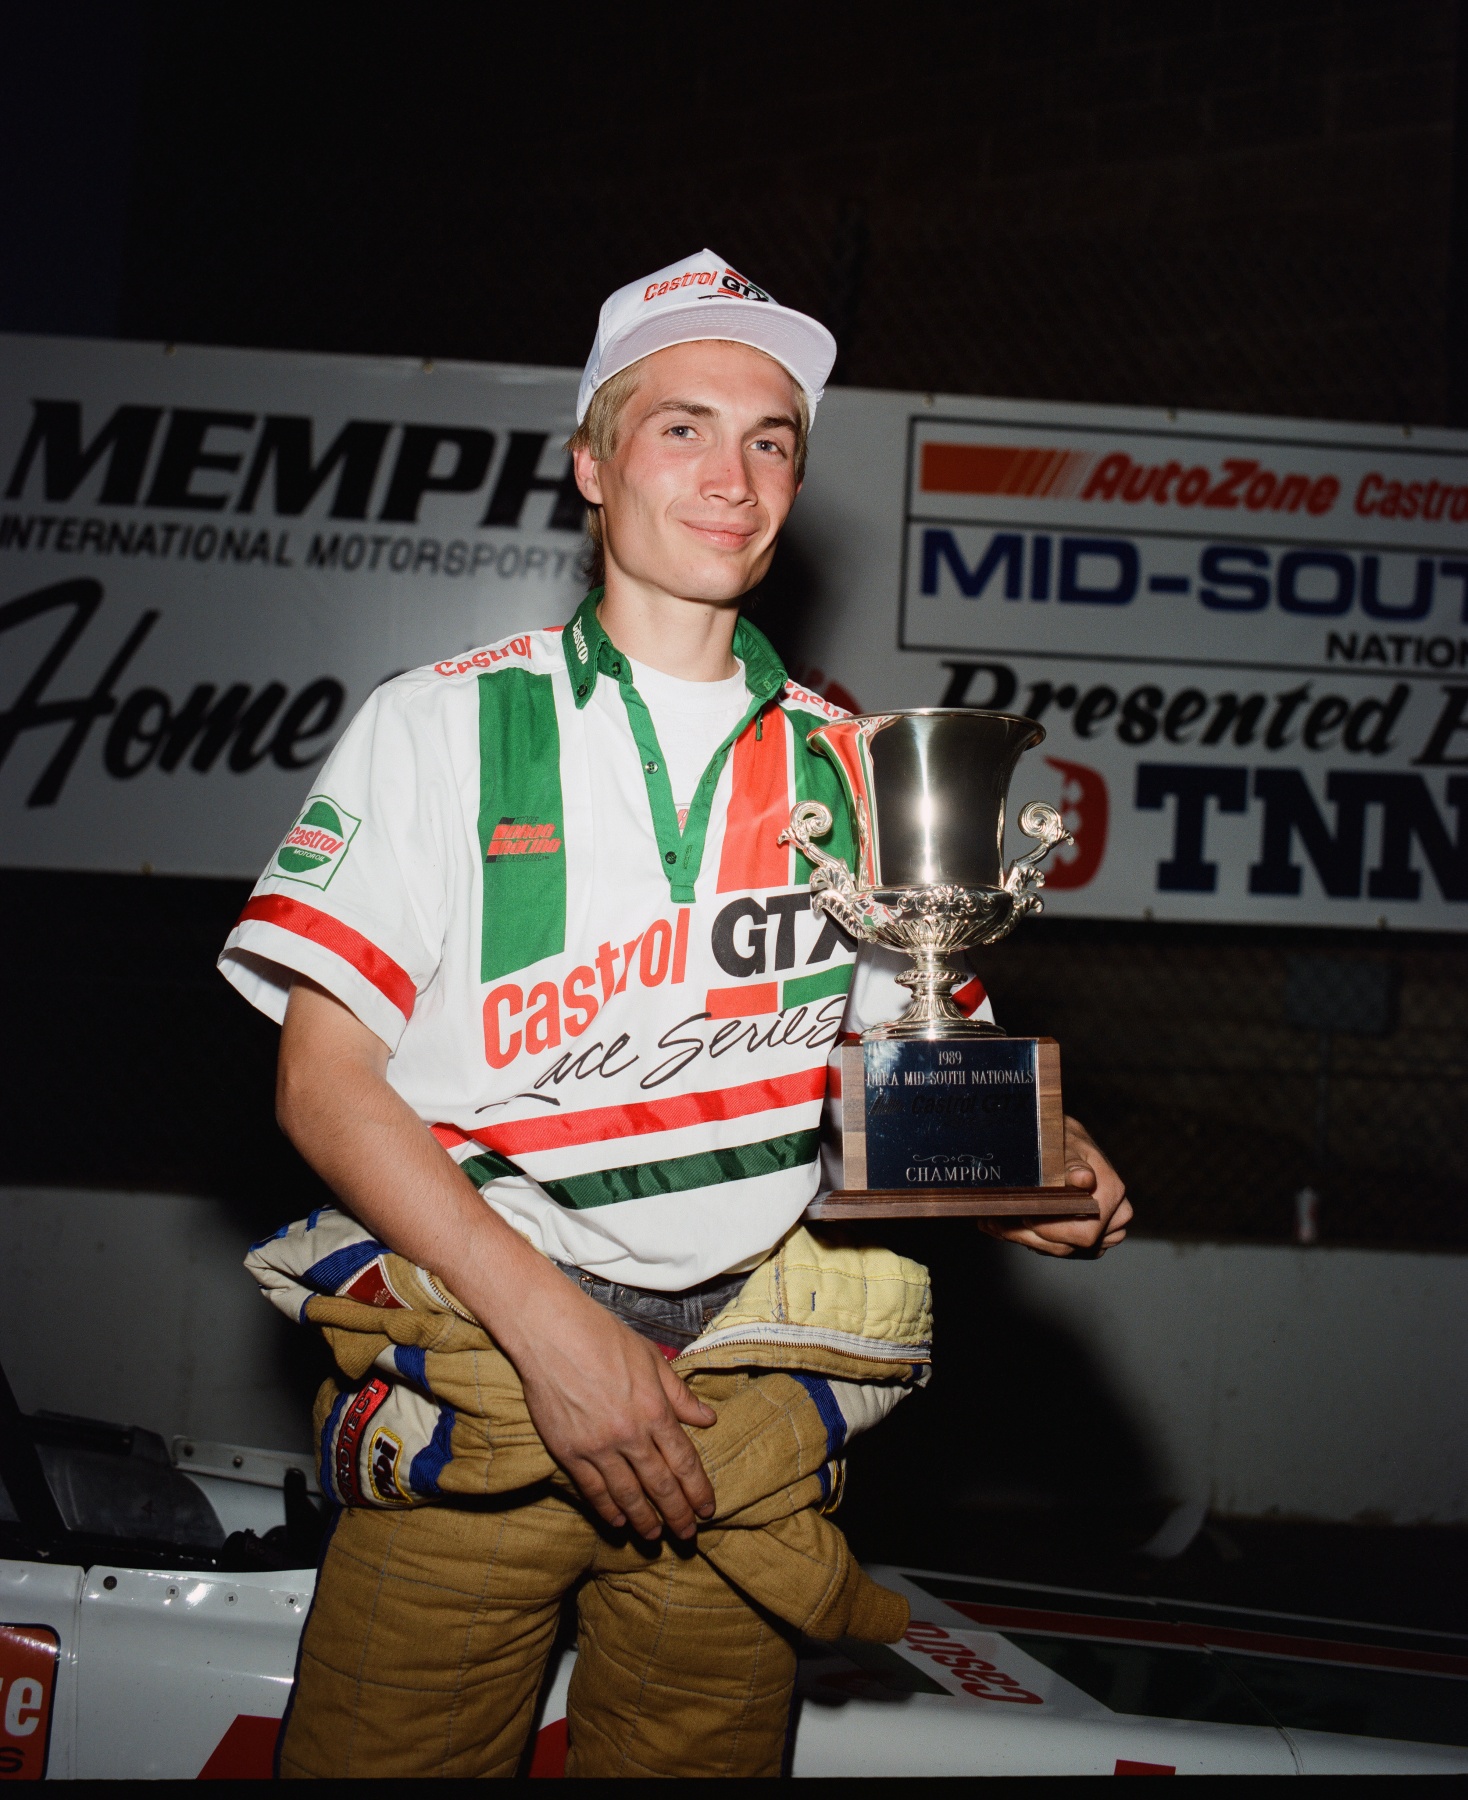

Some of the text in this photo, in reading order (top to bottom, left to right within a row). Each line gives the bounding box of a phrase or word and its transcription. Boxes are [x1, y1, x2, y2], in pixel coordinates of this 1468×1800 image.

[643, 270, 718, 302] Castrol
[6, 399, 587, 532] MEMPH
[1082, 451, 1468, 525] AutoZone Castro
[0, 513, 294, 567] INTERNATIONAL
[433, 635, 533, 677] Castrol
[572, 615, 589, 665] Castrol
[0, 577, 346, 809] Home
[940, 660, 1410, 753] Presented
[286, 826, 344, 854] Castrol
[293, 848, 316, 860] MOTOR
[1134, 761, 1468, 904] TNN
[482, 907, 691, 1070] Castrol
[904, 1070, 967, 1086] MID-SOUTH
[971, 1069, 1034, 1085] NATIONALS
[938, 1050, 963, 1066] 1989
[905, 1165, 1002, 1183] CHAMPION
